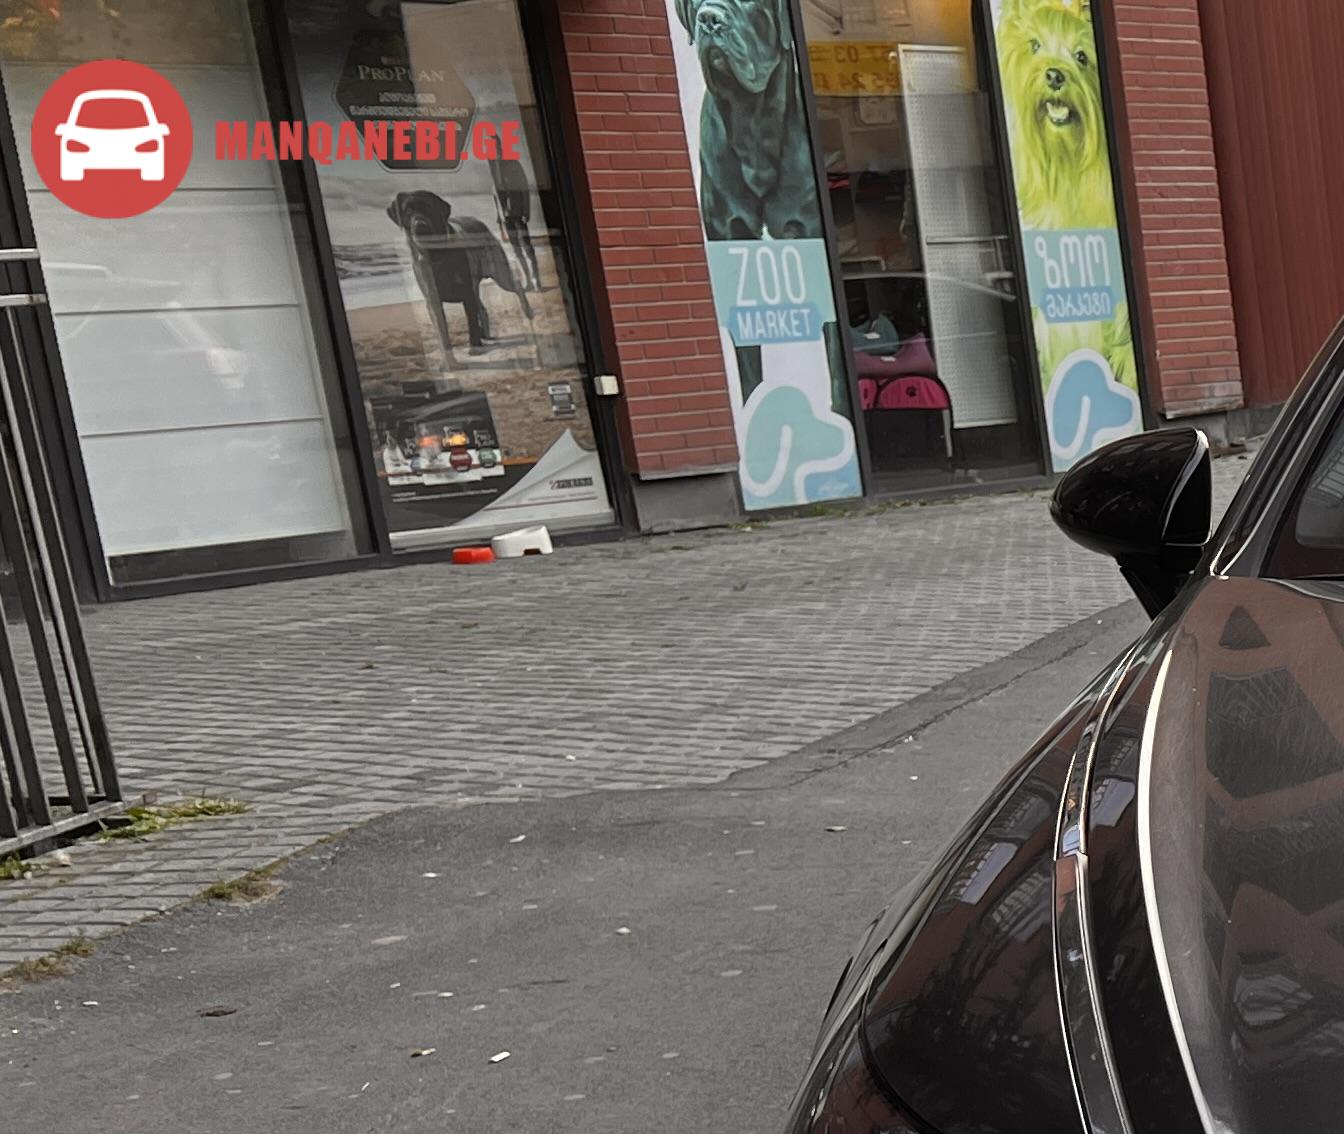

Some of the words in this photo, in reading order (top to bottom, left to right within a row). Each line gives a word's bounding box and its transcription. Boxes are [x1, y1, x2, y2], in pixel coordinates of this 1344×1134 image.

[728, 245, 806, 306] ZOO
[1034, 234, 1111, 289] ზოო
[736, 308, 811, 340] MARKET
